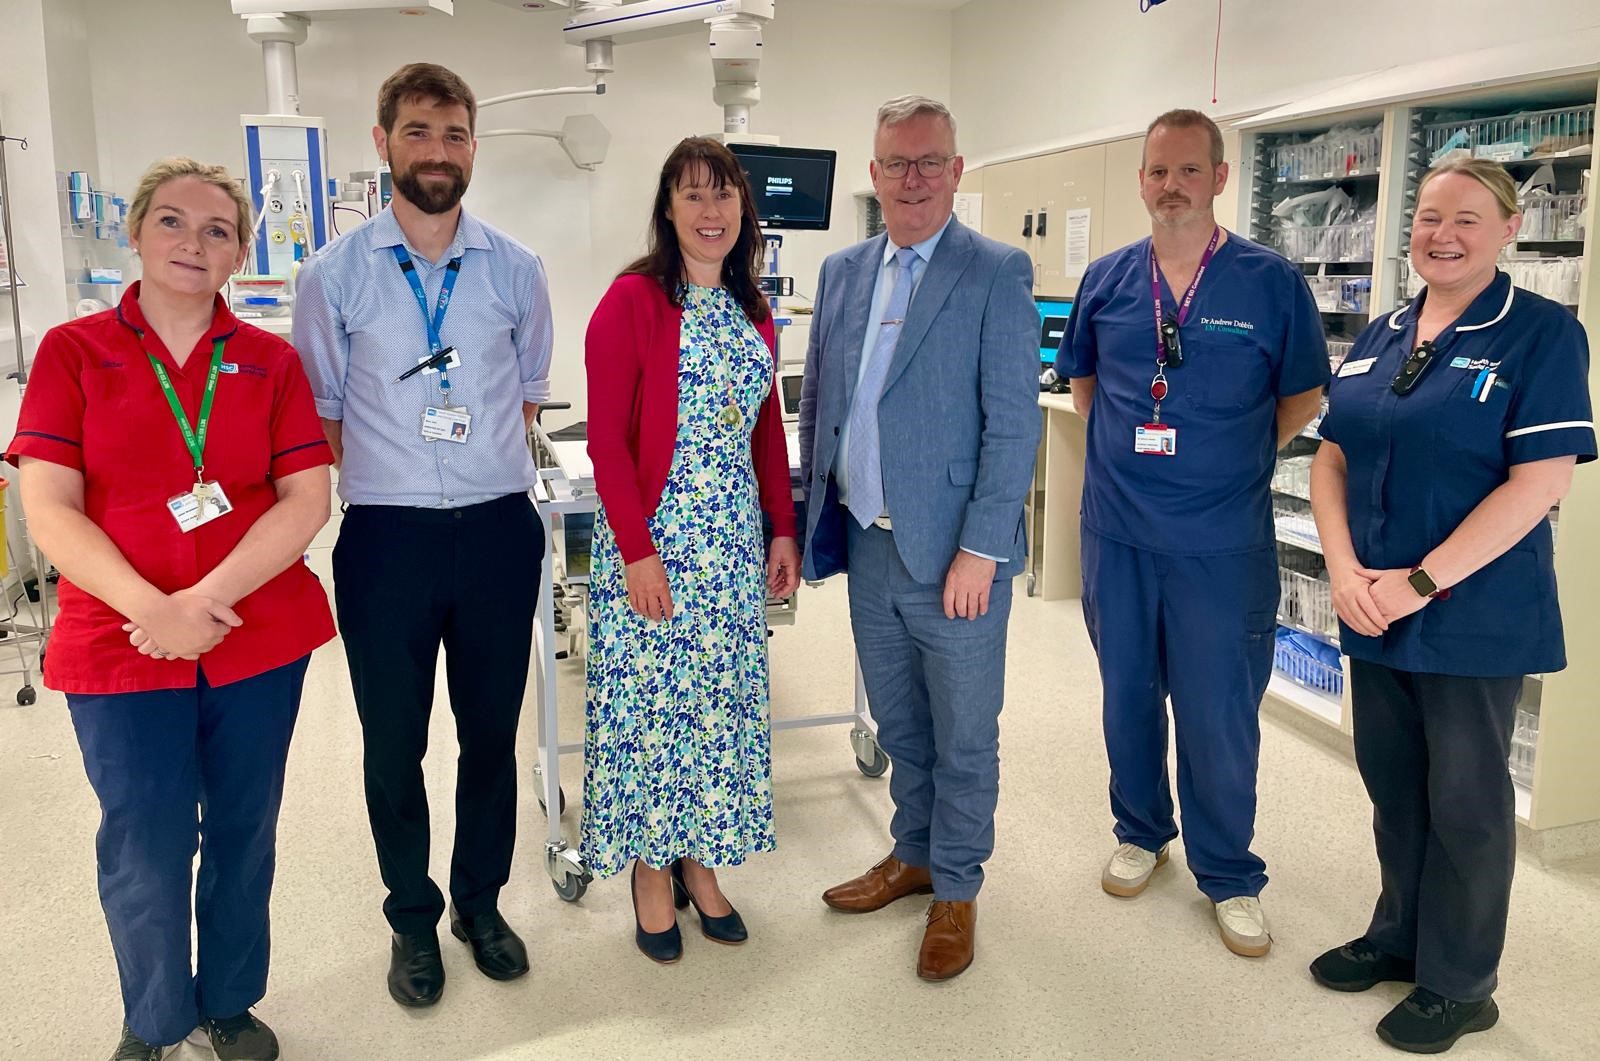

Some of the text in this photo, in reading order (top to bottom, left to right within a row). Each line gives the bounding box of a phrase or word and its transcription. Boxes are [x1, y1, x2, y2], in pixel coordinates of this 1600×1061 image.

[1192, 265, 1205, 289] Consultant
[1233, 320, 1253, 330] Dobbin
[1217, 326, 1248, 335] Consultant
